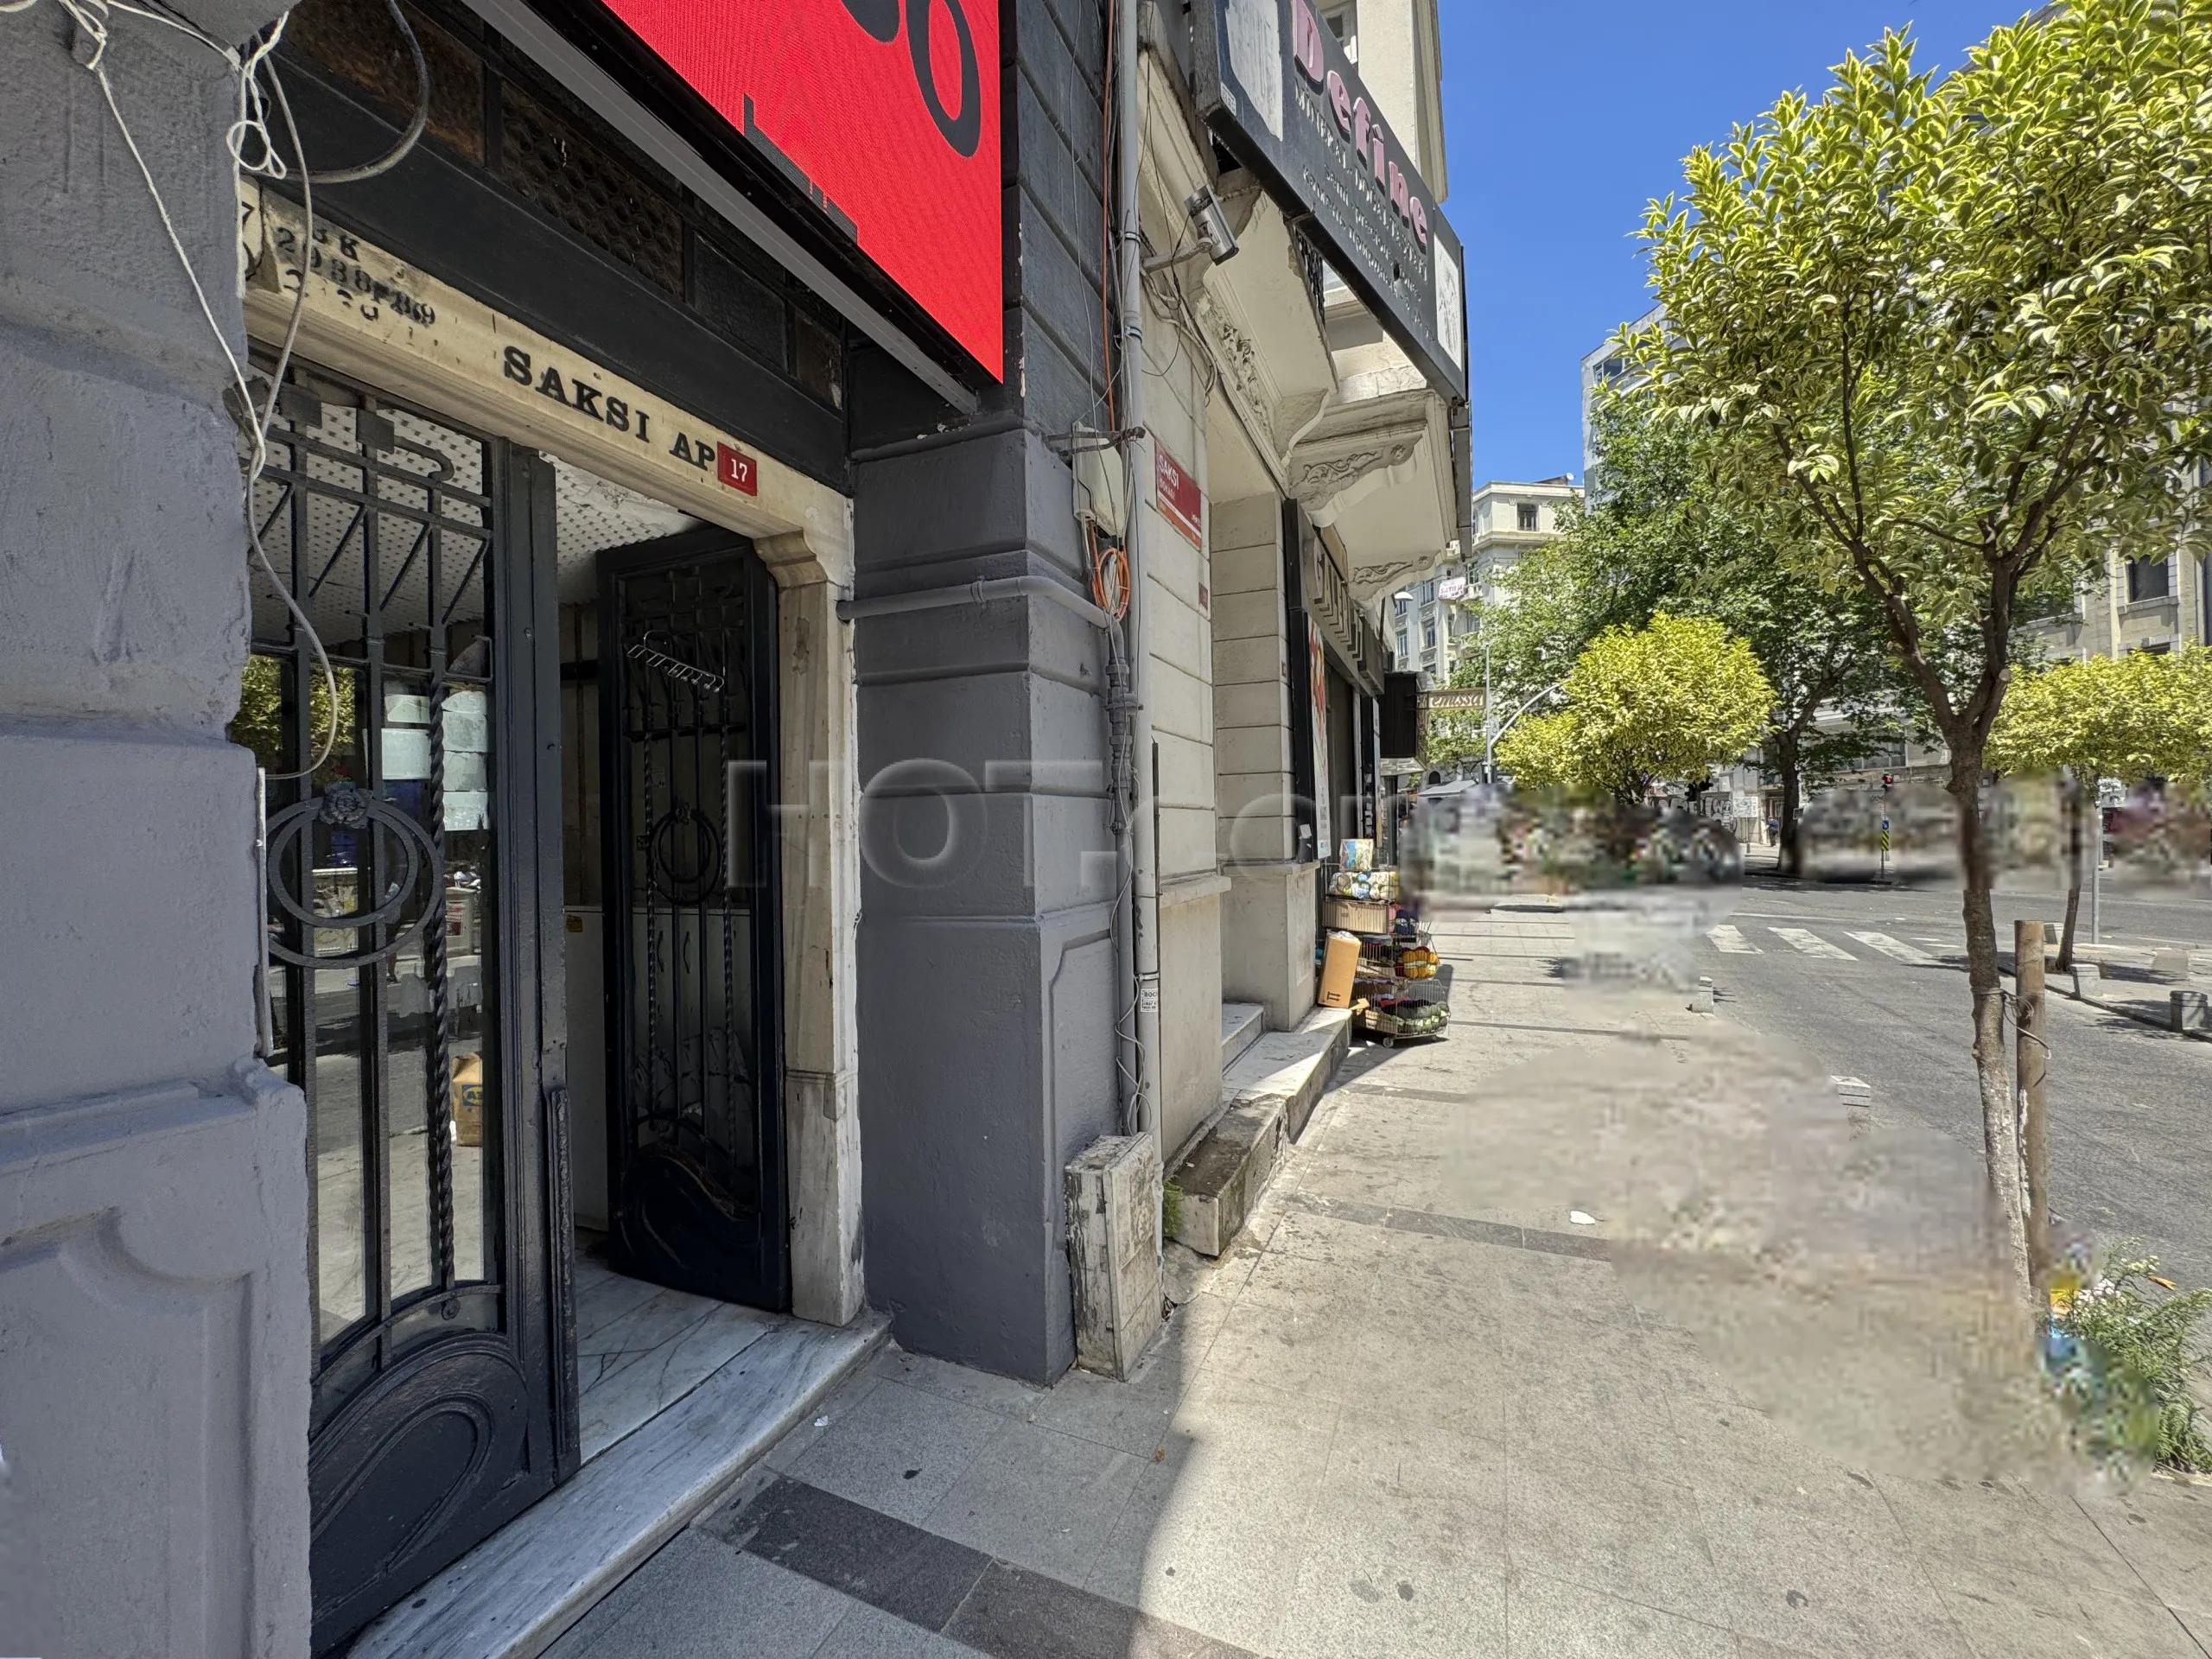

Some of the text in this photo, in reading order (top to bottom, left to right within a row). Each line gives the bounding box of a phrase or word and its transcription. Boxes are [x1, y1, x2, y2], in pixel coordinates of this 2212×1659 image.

[1293, 0, 1427, 245] Define
[504, 346, 716, 471] SAKSI AP
[730, 458, 748, 483] 17
[1159, 454, 1179, 490] SAKSI
